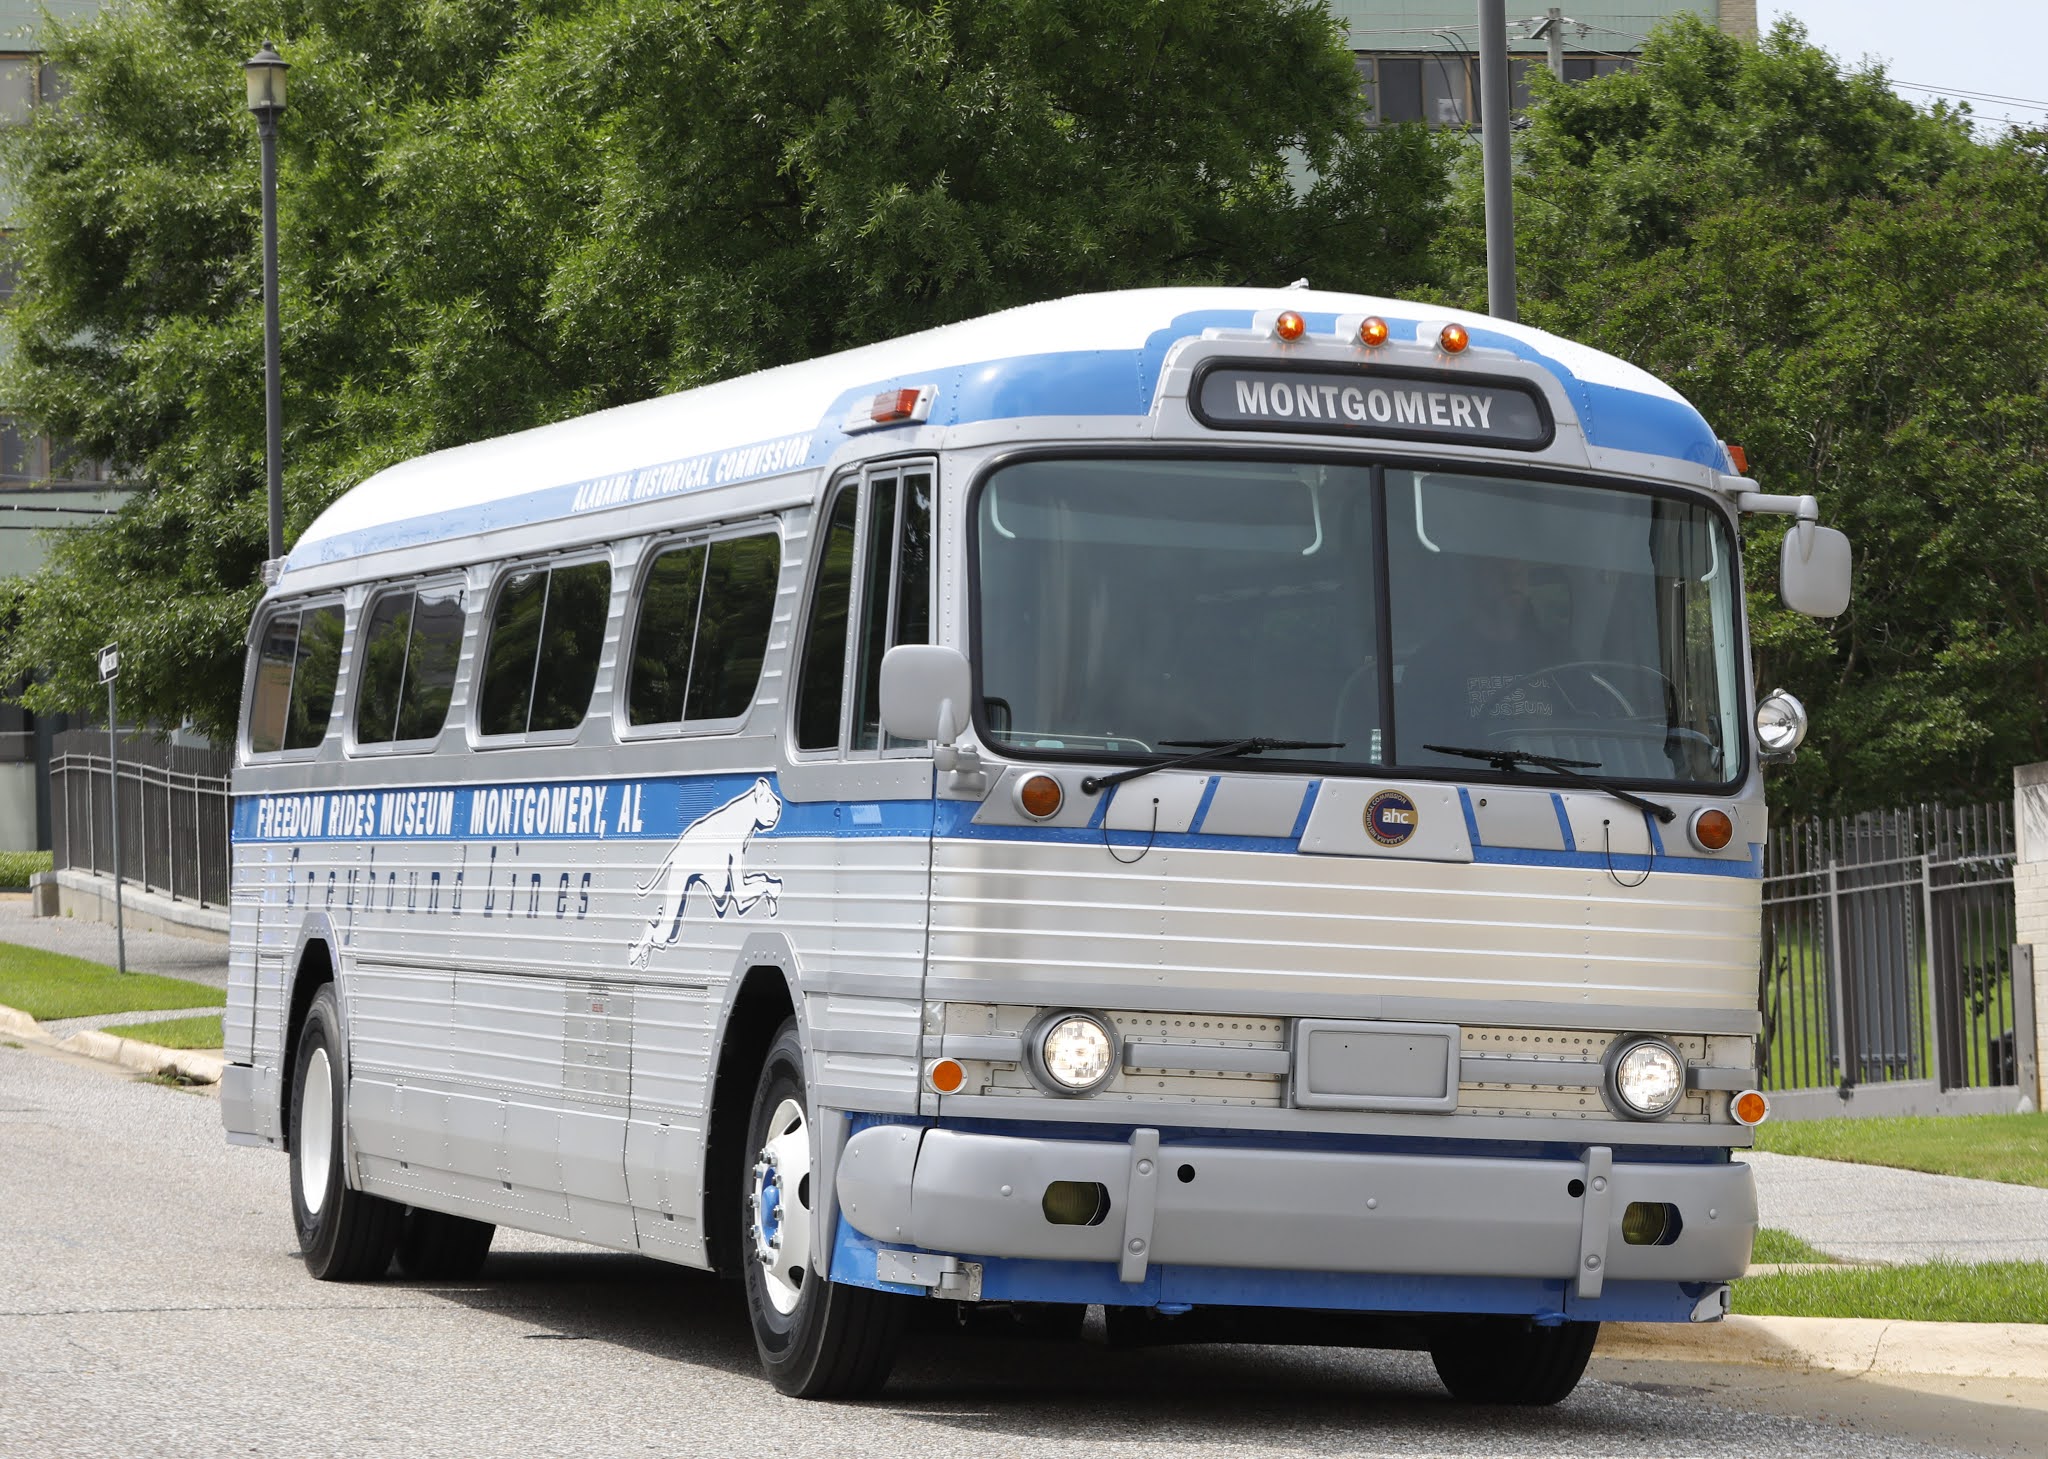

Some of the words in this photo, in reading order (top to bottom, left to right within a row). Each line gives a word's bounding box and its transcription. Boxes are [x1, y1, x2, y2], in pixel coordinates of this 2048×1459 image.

[1235, 380, 1493, 429] MONTGOMERY
[571, 474, 636, 512] ALABAMA
[632, 456, 710, 500] HISTORICAL
[714, 436, 812, 483] COMMISSION
[257, 795, 325, 837] FREEDOM
[327, 793, 376, 836] RIDES
[379, 791, 455, 836] MUSEUM
[469, 786, 607, 839] MONTGOMERY,
[617, 784, 642, 833] AL
[1382, 808, 1409, 825] ahc
[287, 845, 467, 945] Greyhound
